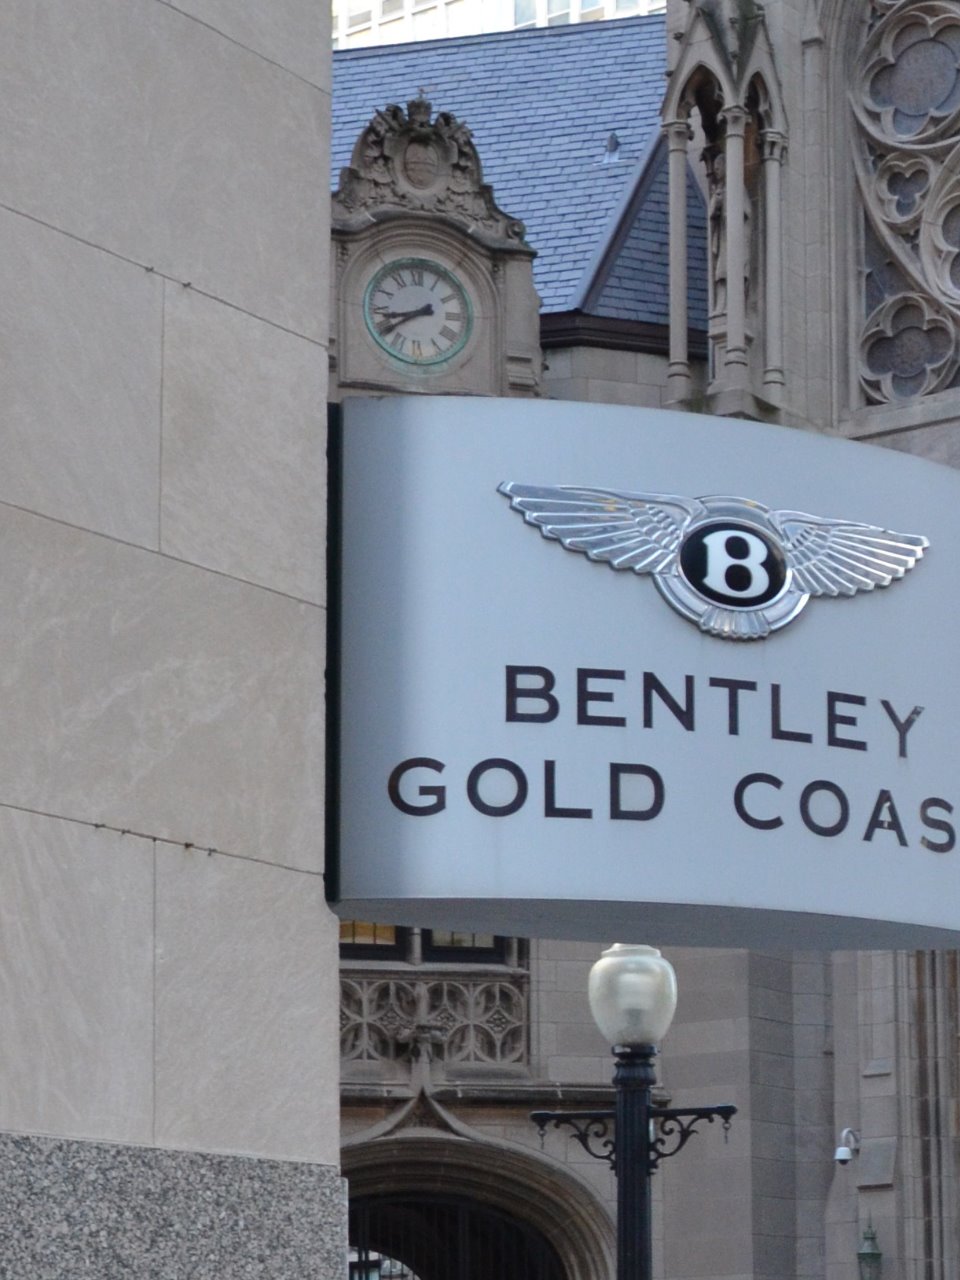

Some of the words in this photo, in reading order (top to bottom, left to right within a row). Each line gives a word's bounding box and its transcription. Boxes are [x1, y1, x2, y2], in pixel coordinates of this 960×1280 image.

[702, 529, 771, 598] B
[505, 664, 925, 760] BENTLEY
[387, 757, 666, 822] GOLD
